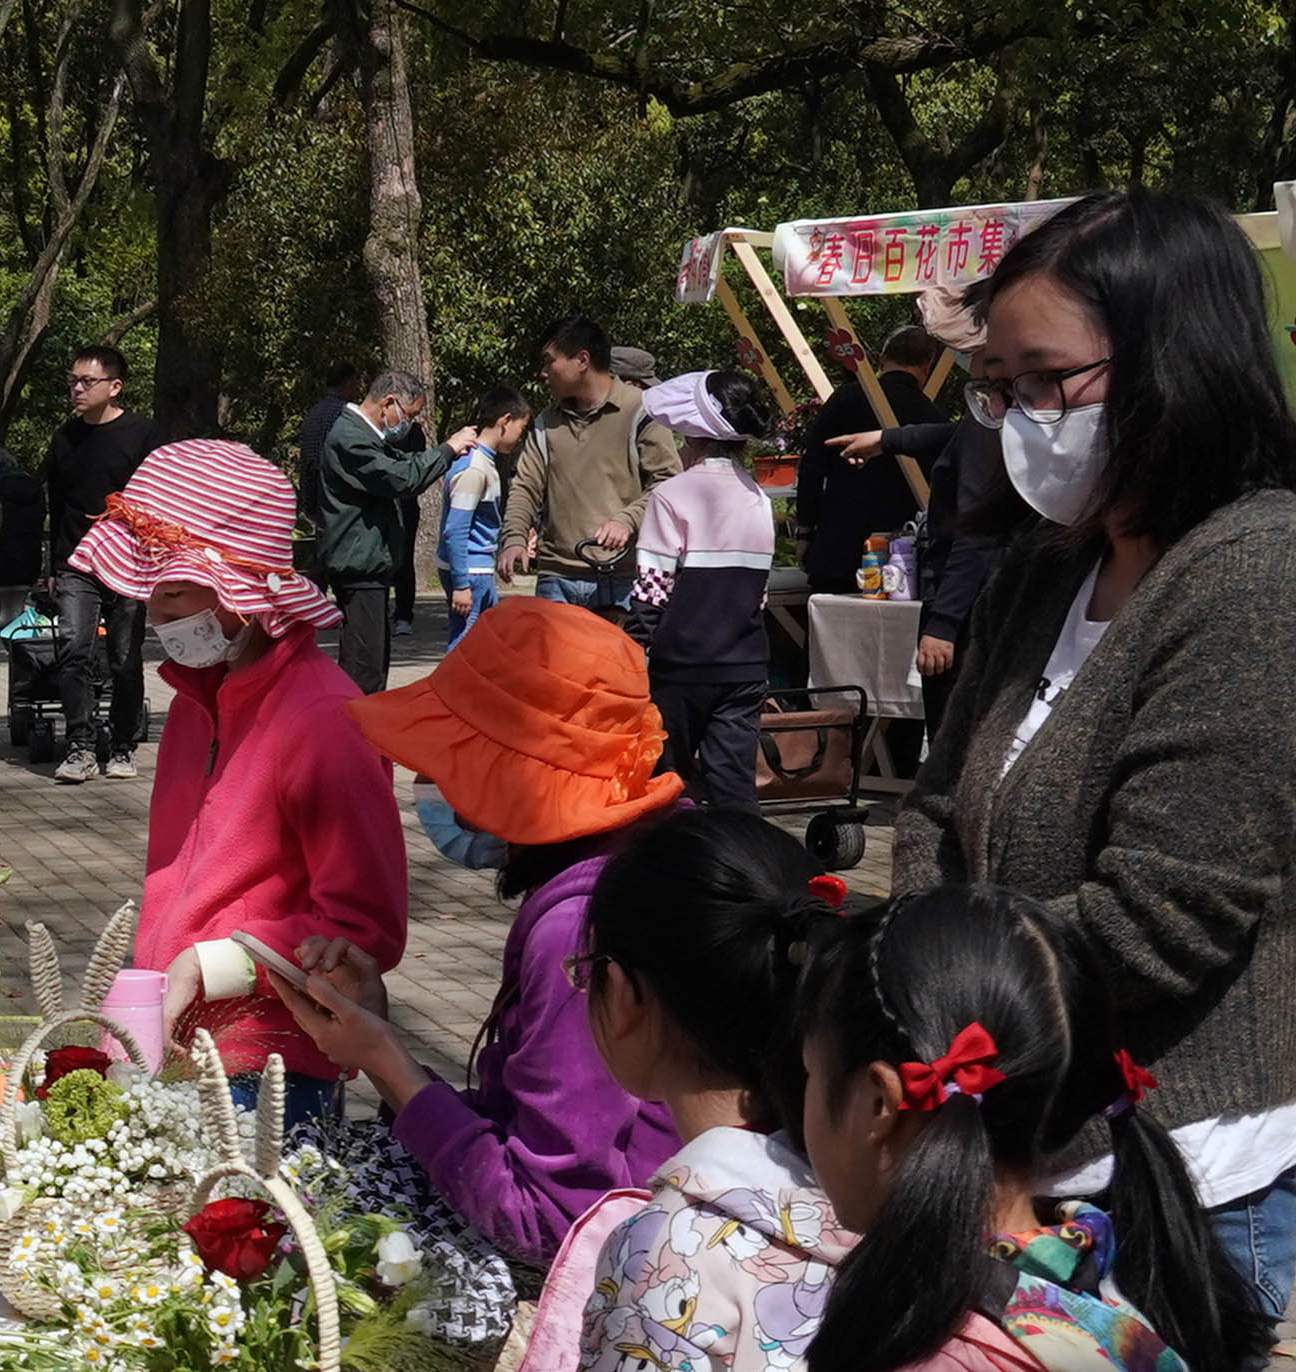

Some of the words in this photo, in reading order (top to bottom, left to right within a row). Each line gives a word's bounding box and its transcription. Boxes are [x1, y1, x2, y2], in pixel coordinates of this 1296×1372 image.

[815, 219, 1005, 286] 春日百花市集
